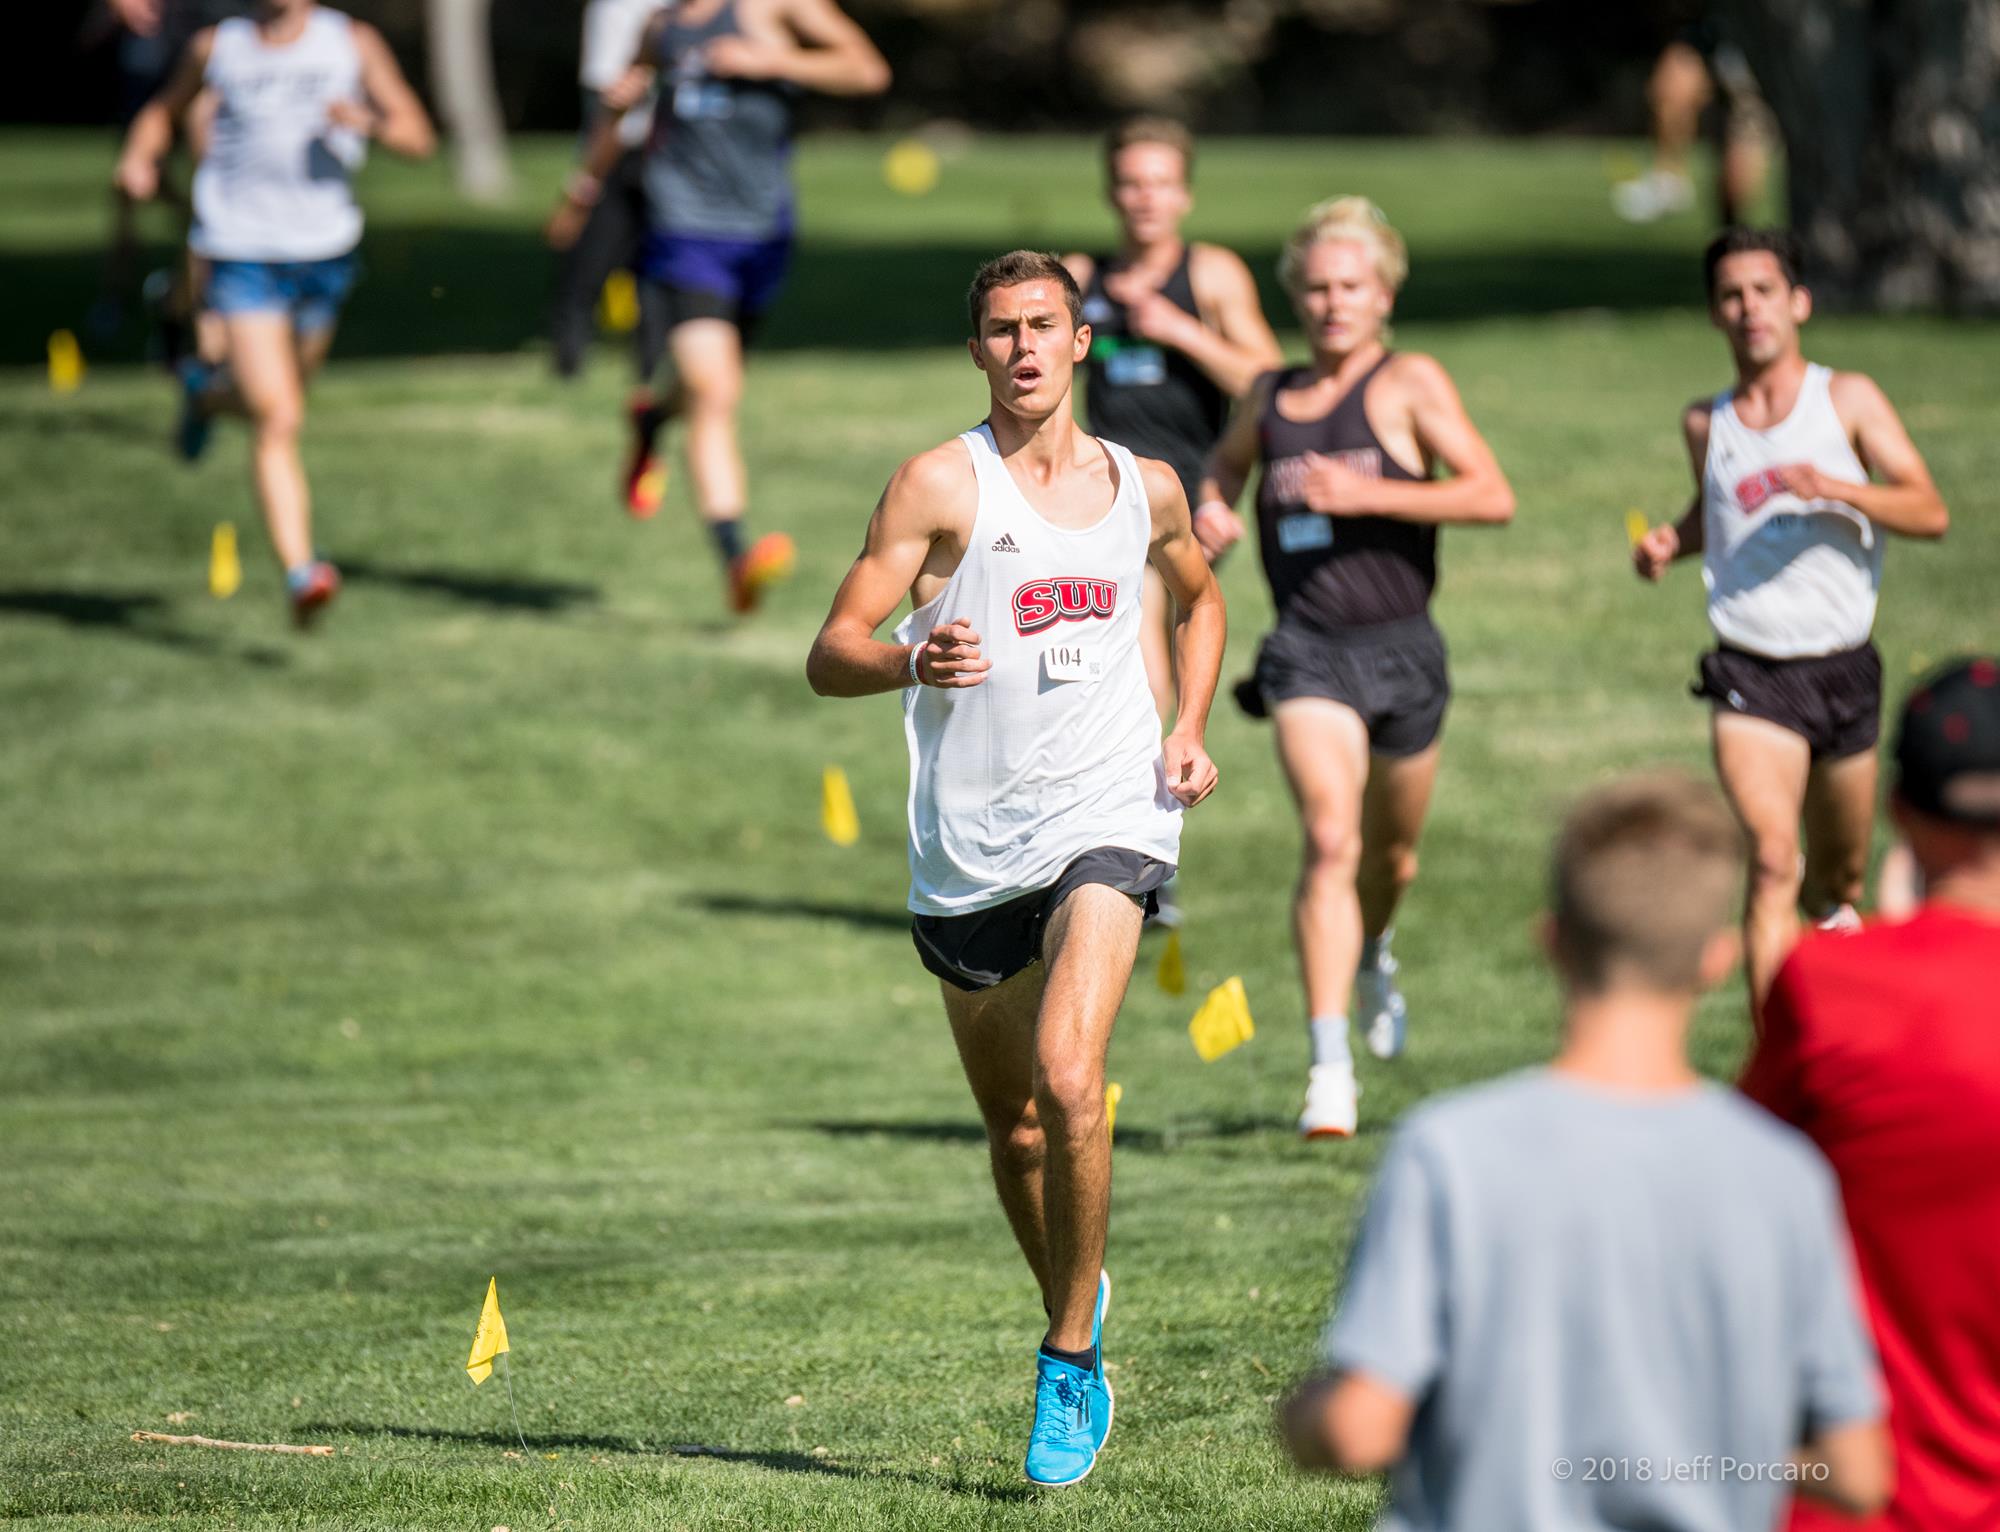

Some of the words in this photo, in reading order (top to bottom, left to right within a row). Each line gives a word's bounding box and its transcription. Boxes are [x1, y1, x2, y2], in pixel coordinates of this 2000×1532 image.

[991, 544, 1020, 553] adidas
[1012, 577, 1118, 637] SUU
[1050, 647, 1082, 667] 104
